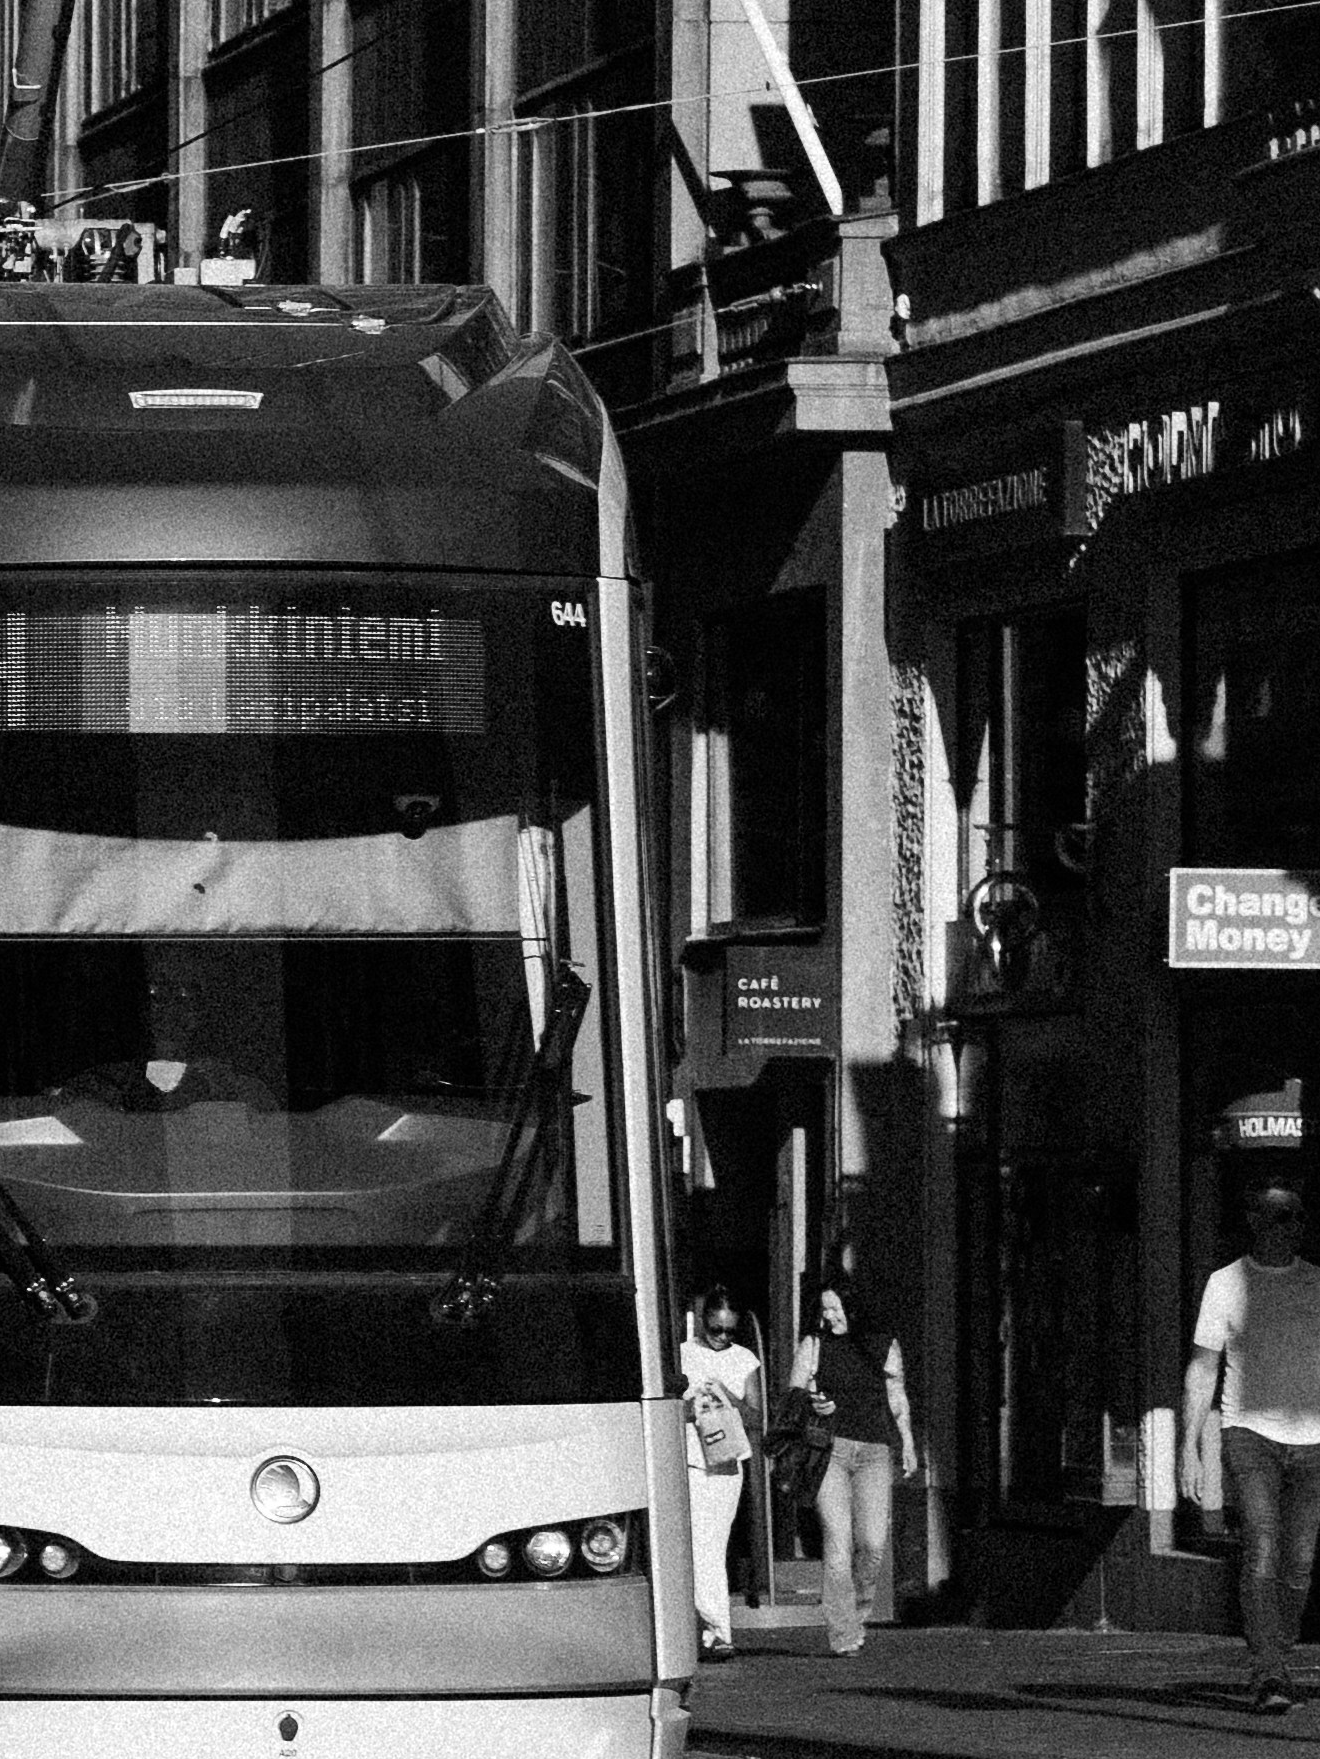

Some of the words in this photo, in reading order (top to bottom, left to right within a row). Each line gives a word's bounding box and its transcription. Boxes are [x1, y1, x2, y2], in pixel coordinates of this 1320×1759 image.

[551, 601, 586, 627] 644
[106, 605, 444, 660] Munkkiniemi
[1186, 919, 1311, 960] Money
[738, 996, 821, 1009] ROASTERY
